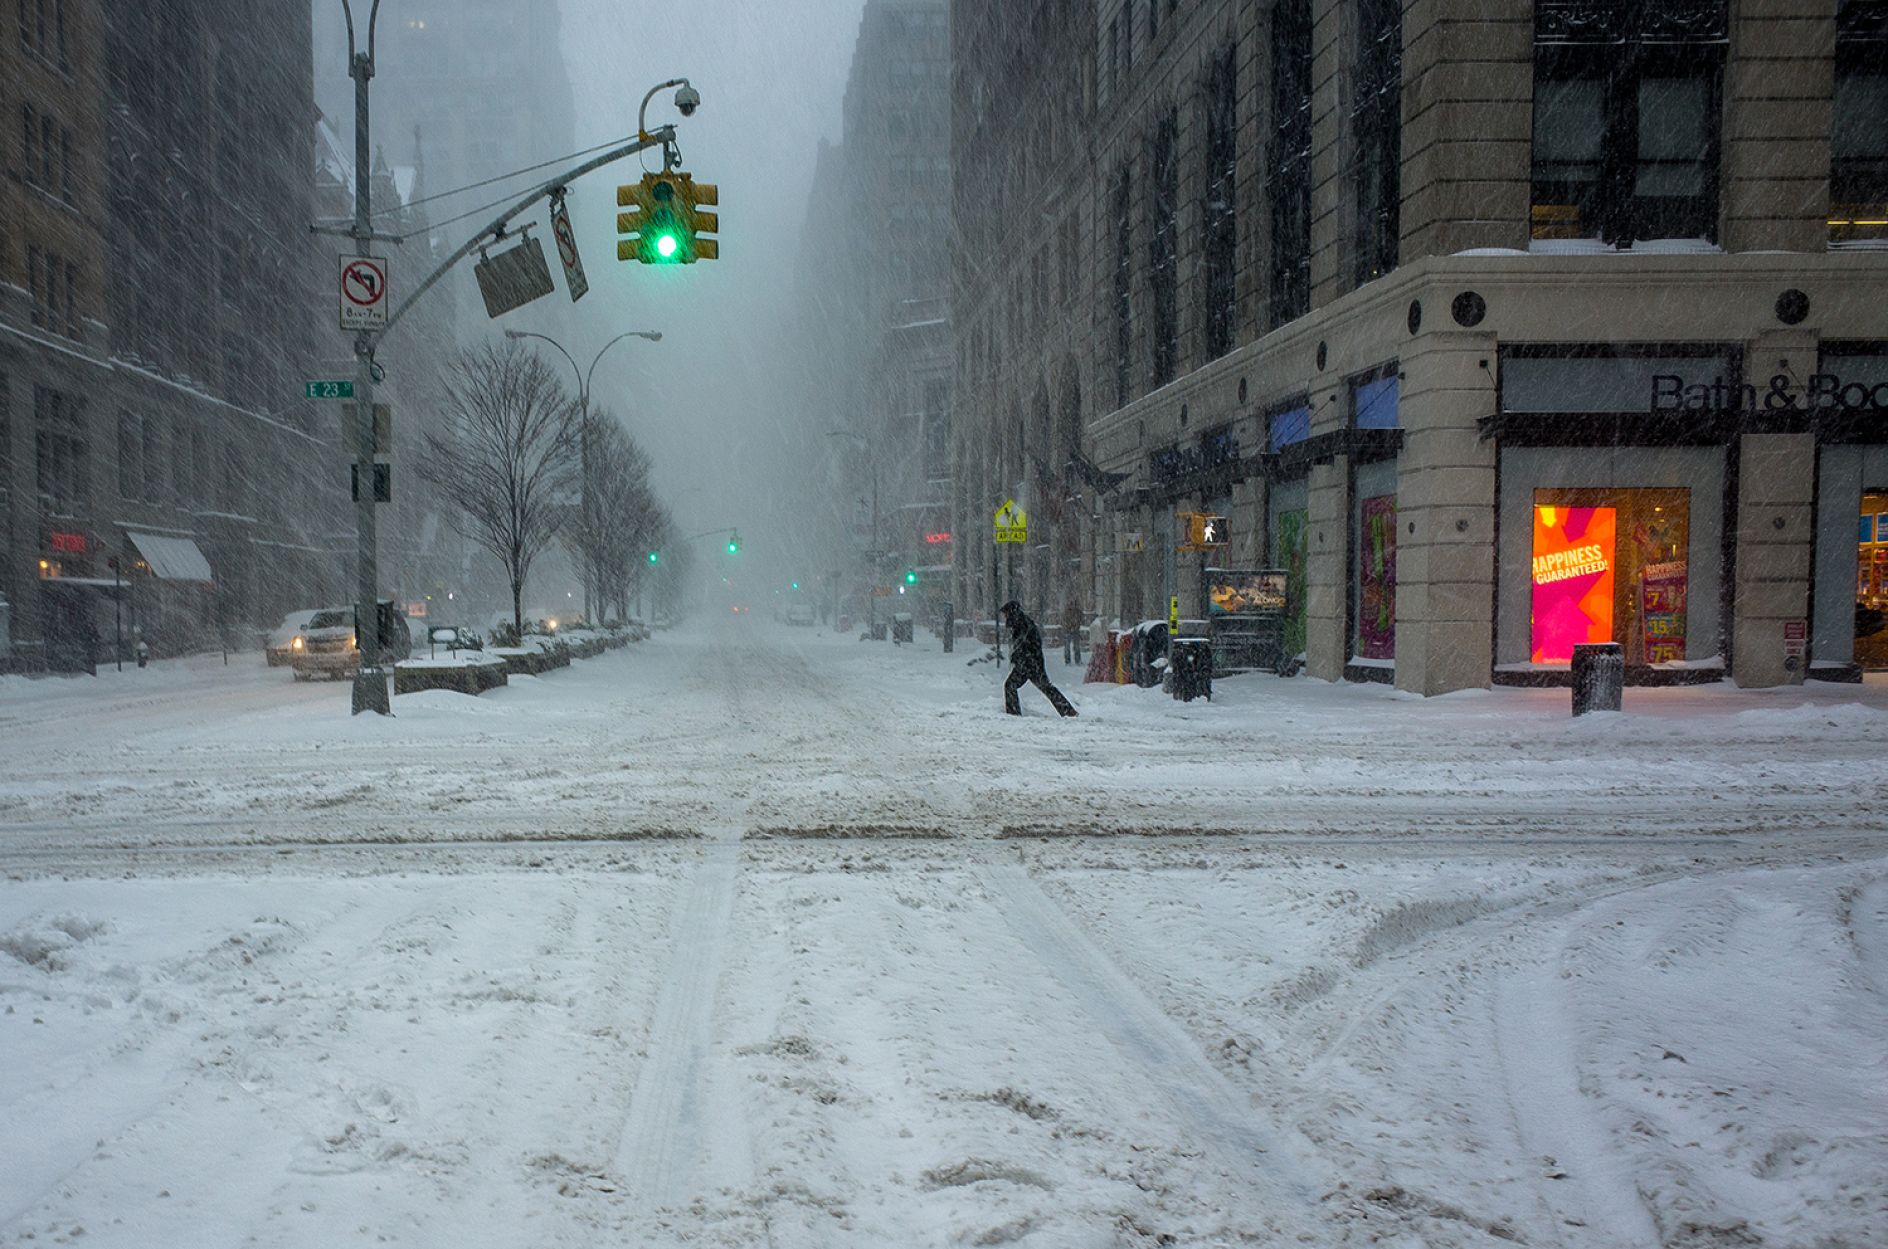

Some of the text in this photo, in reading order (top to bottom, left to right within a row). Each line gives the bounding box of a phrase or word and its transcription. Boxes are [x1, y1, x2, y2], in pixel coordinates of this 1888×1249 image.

[310, 383, 317, 397] E
[323, 383, 339, 397] 23
[1652, 374, 1757, 411] Bath
[1764, 374, 1804, 411] &
[1533, 544, 1602, 573] HAPPINESS
[1536, 560, 1609, 585] GUARANTEED!
